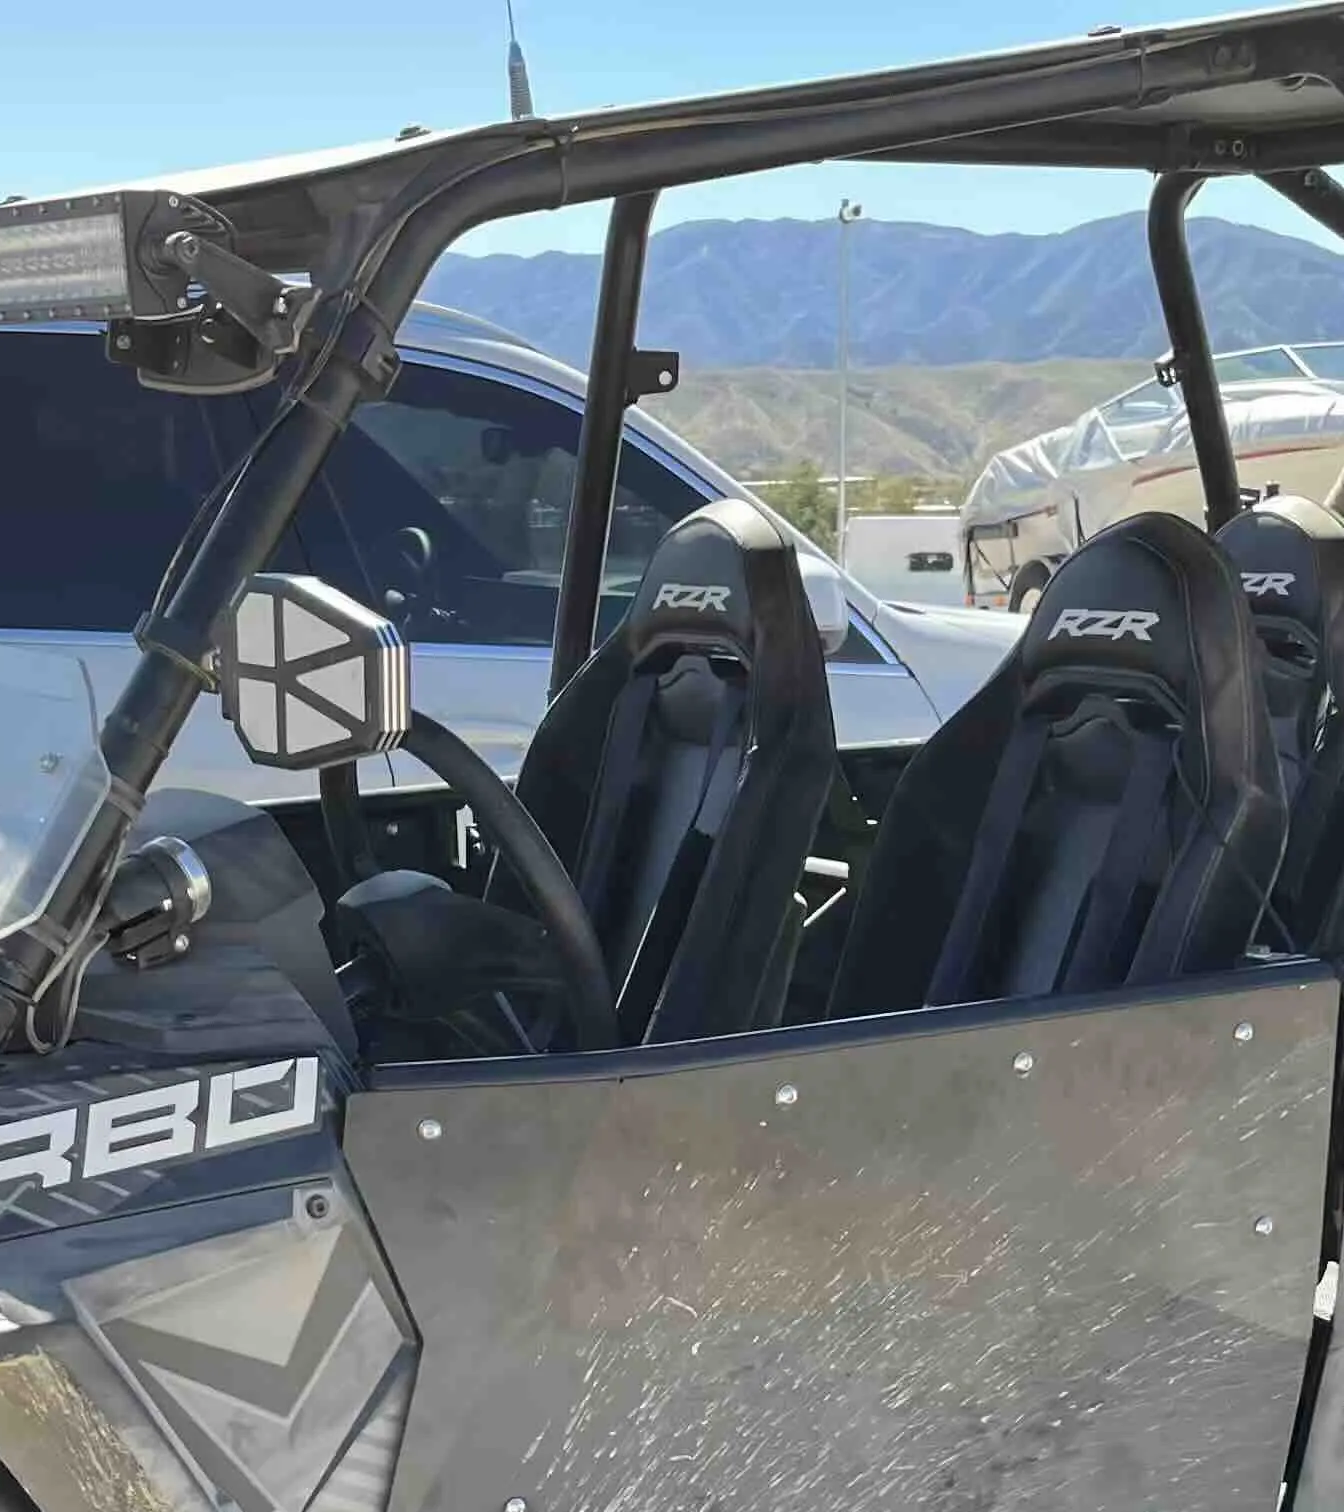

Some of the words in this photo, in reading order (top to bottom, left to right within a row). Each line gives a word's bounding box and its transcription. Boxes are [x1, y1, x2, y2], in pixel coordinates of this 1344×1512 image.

[652, 583, 731, 612] RZR
[1240, 572, 1296, 597] ZR
[1047, 608, 1160, 641] RZR
